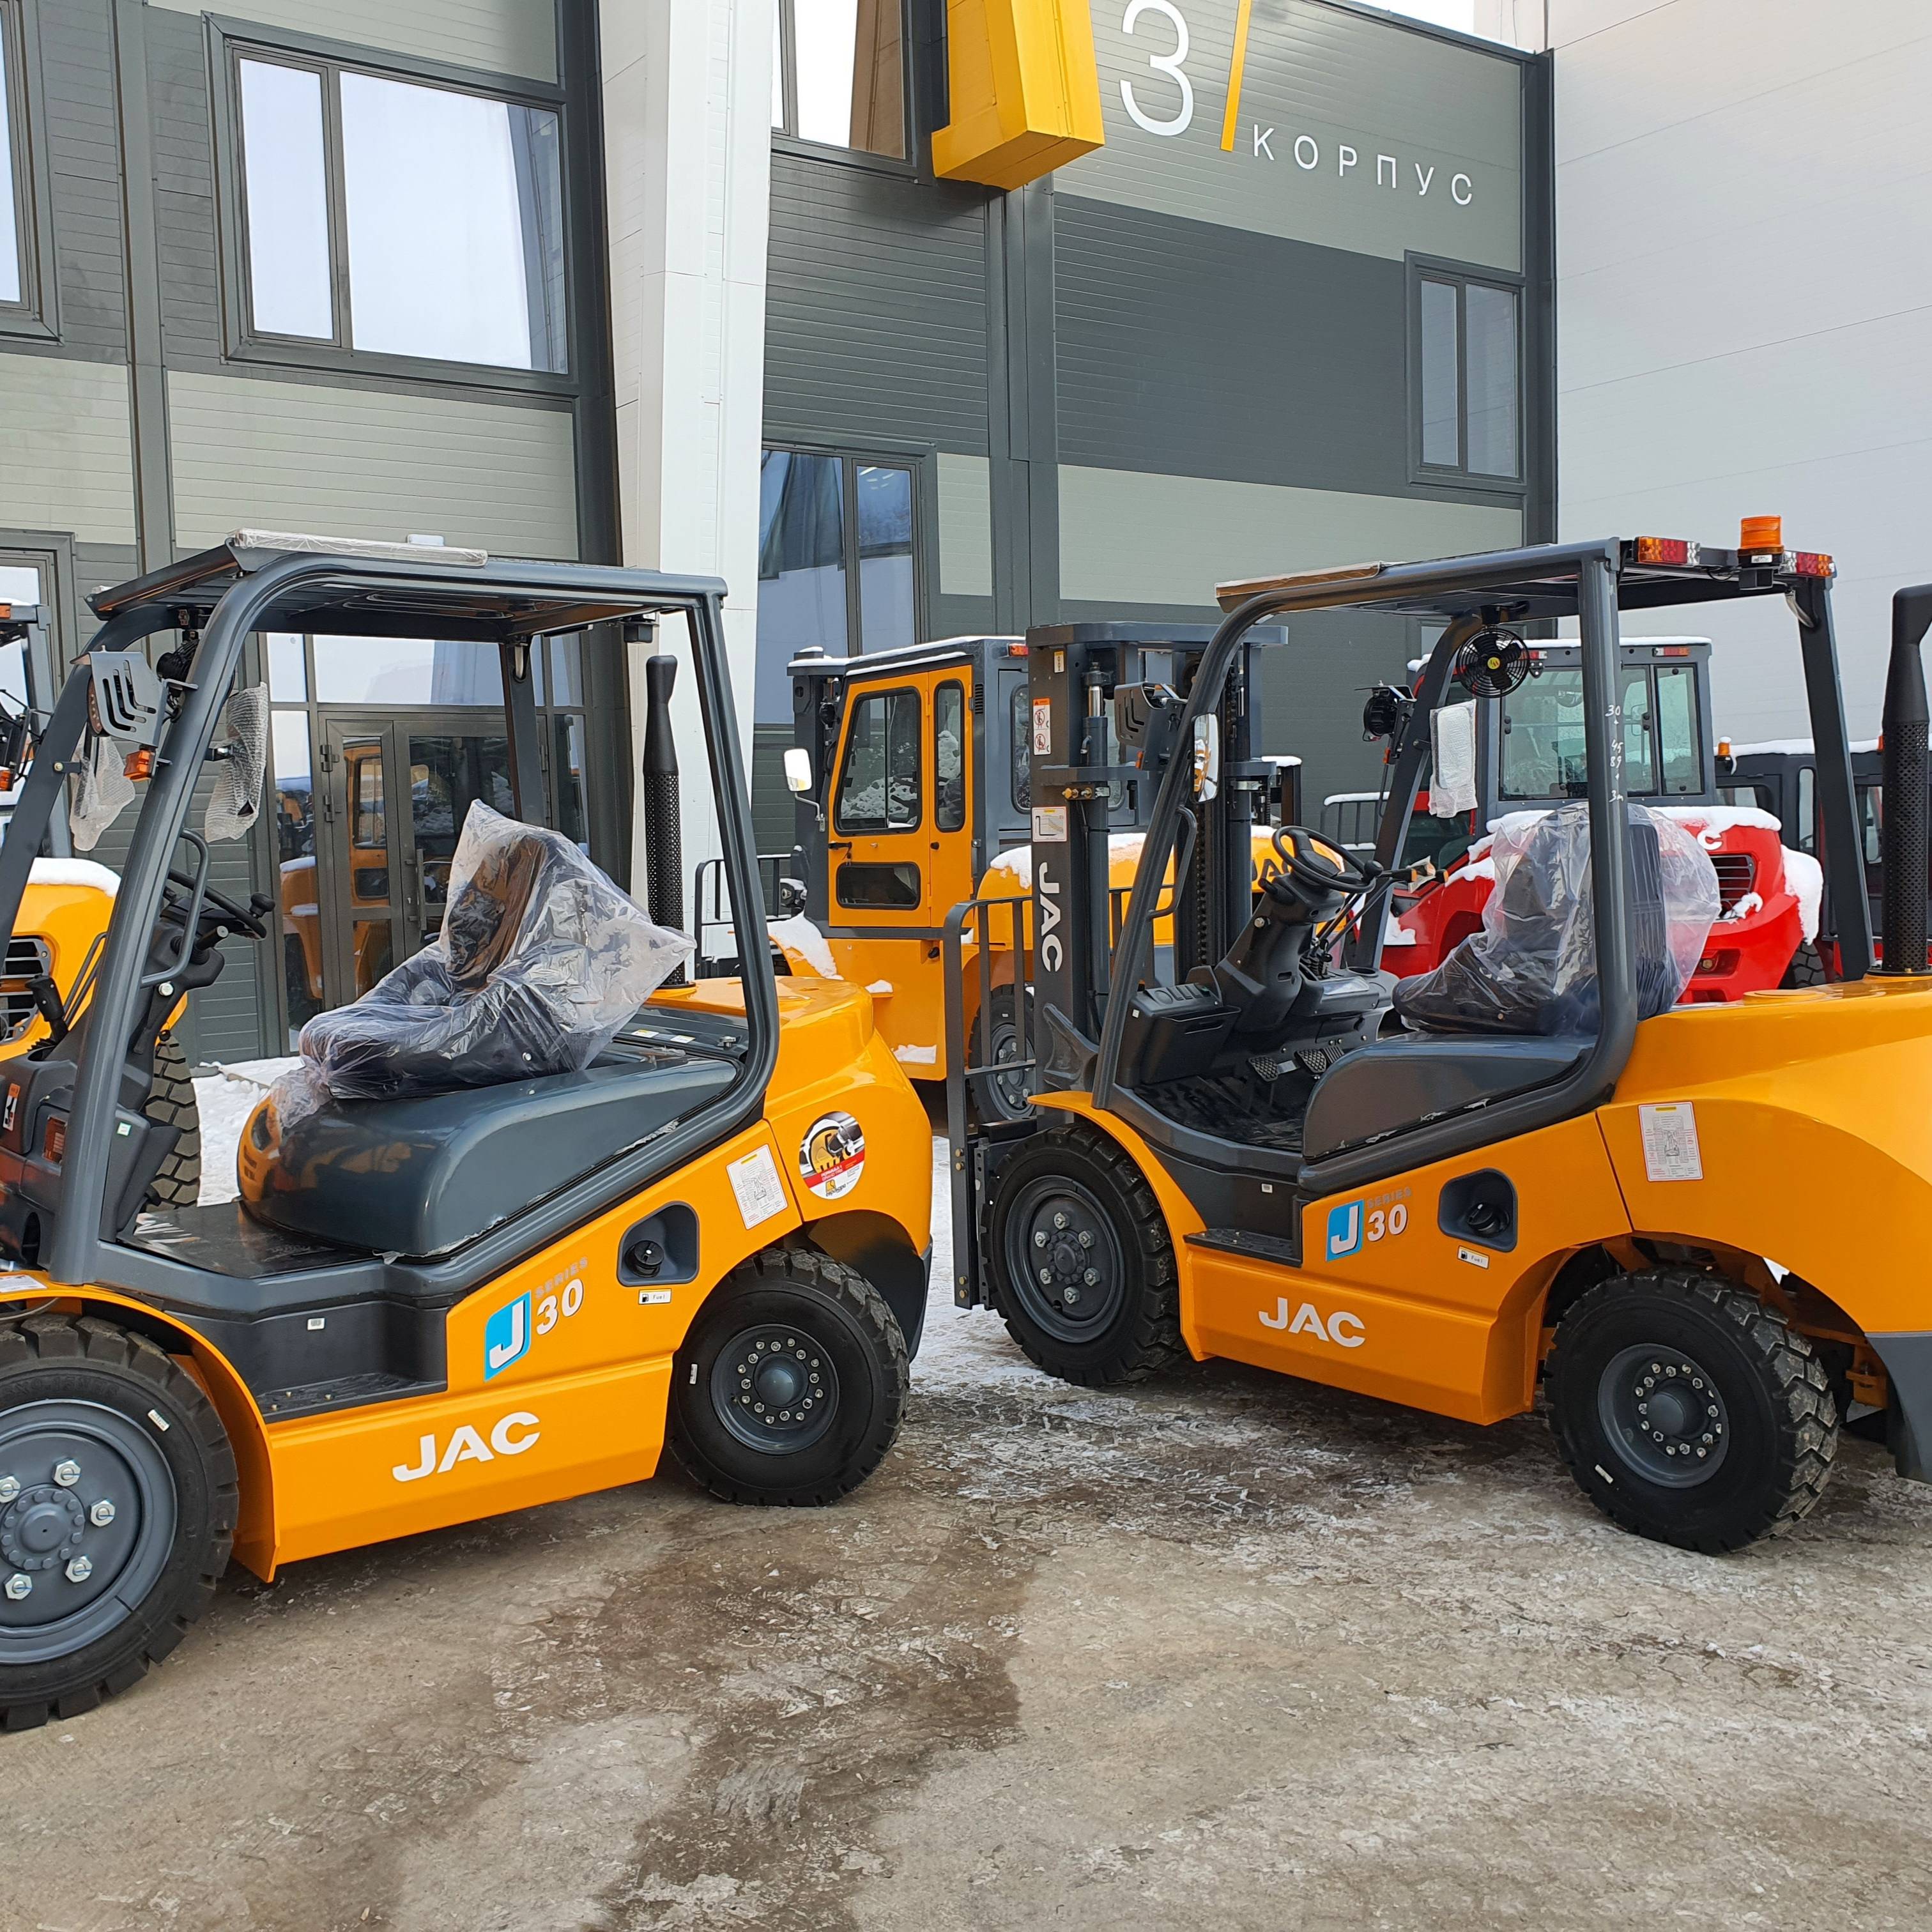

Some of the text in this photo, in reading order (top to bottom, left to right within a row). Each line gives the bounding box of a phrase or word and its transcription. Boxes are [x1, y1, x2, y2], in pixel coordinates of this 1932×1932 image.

[1119, 0, 1194, 136] 3
[1253, 123, 1473, 205] КОРПУС
[1038, 862, 1063, 972] JAC
[1367, 1204, 1409, 1242] 30
[536, 1278, 585, 1336] 30
[1258, 1296, 1366, 1348] JAC
[392, 1411, 541, 1482] JAC
